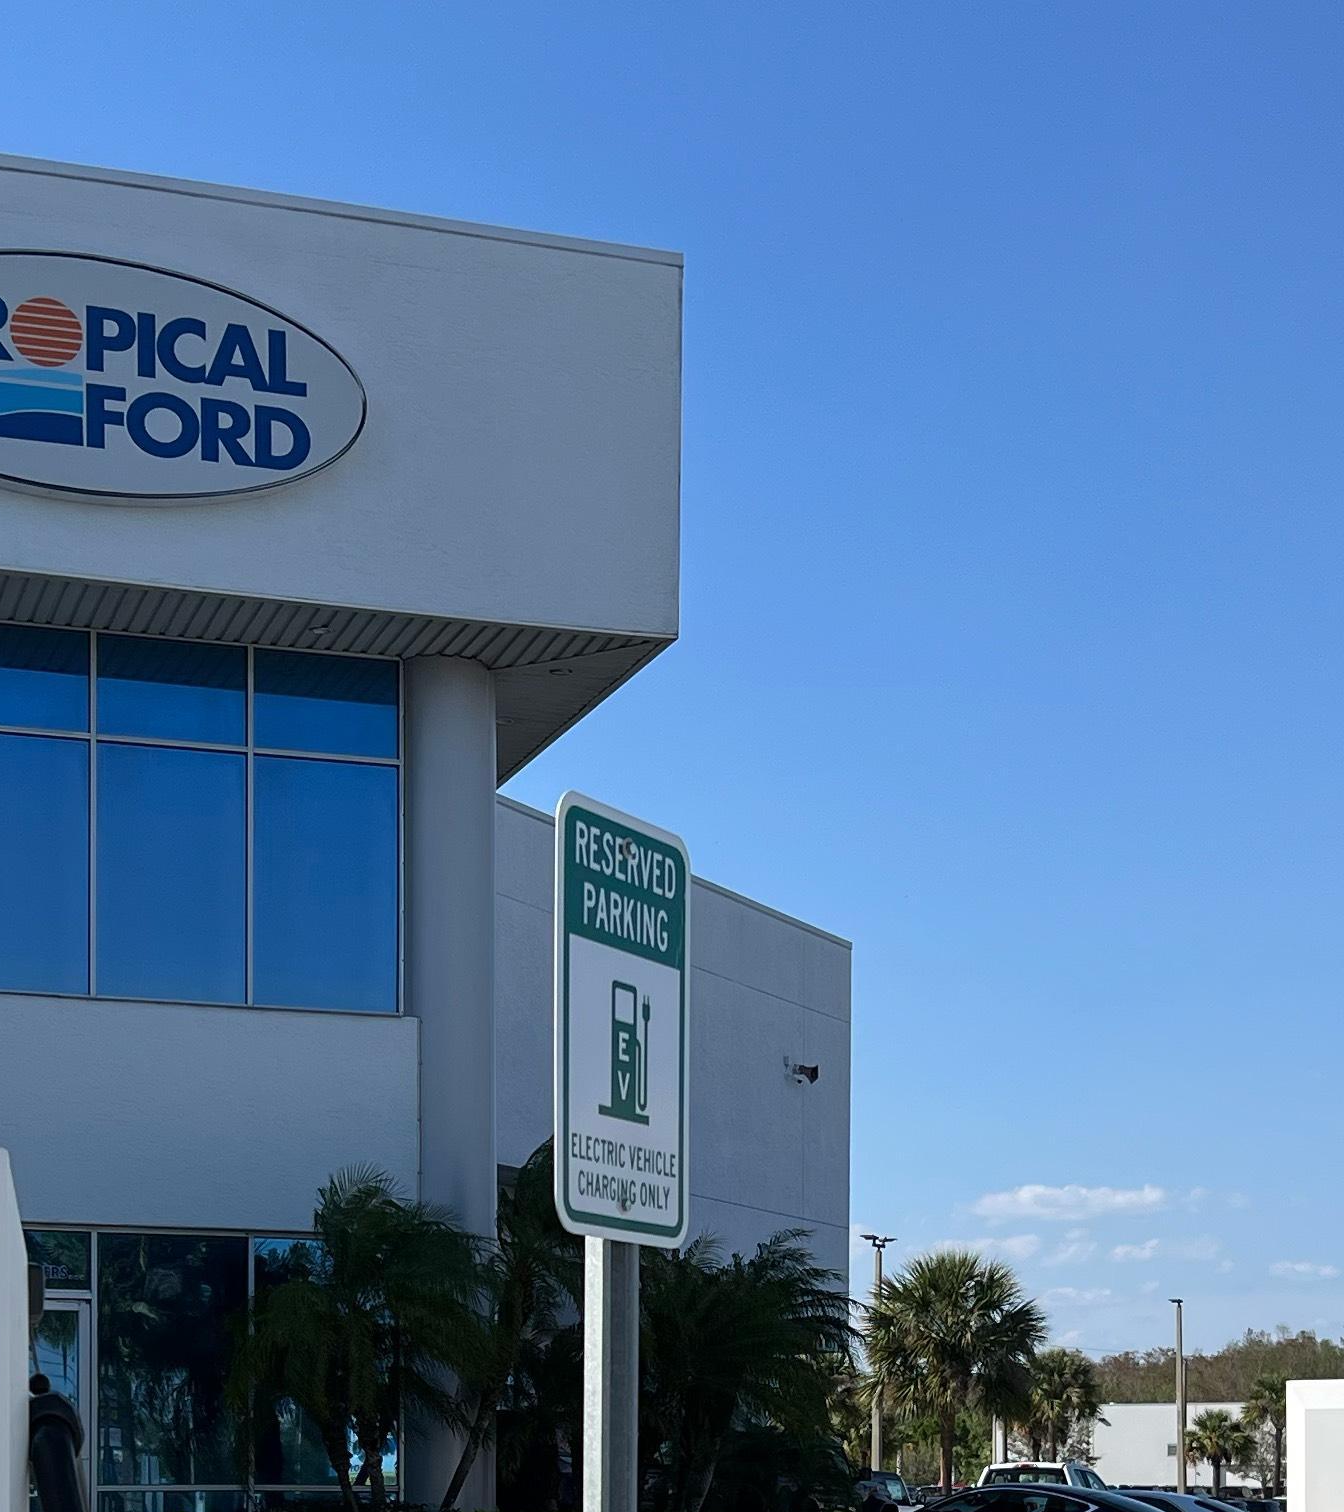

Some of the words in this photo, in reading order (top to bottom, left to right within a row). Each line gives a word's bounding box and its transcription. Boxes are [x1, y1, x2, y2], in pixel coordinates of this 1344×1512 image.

[86, 383, 311, 470] FORD
[575, 820, 676, 899] RESERVED
[583, 882, 668, 952] PARKING
[571, 1133, 626, 1169] ELECTRIC
[629, 1145, 676, 1178] VEHICLE
[578, 1171, 636, 1205] CHARGING
[640, 1183, 670, 1211] ONLY
